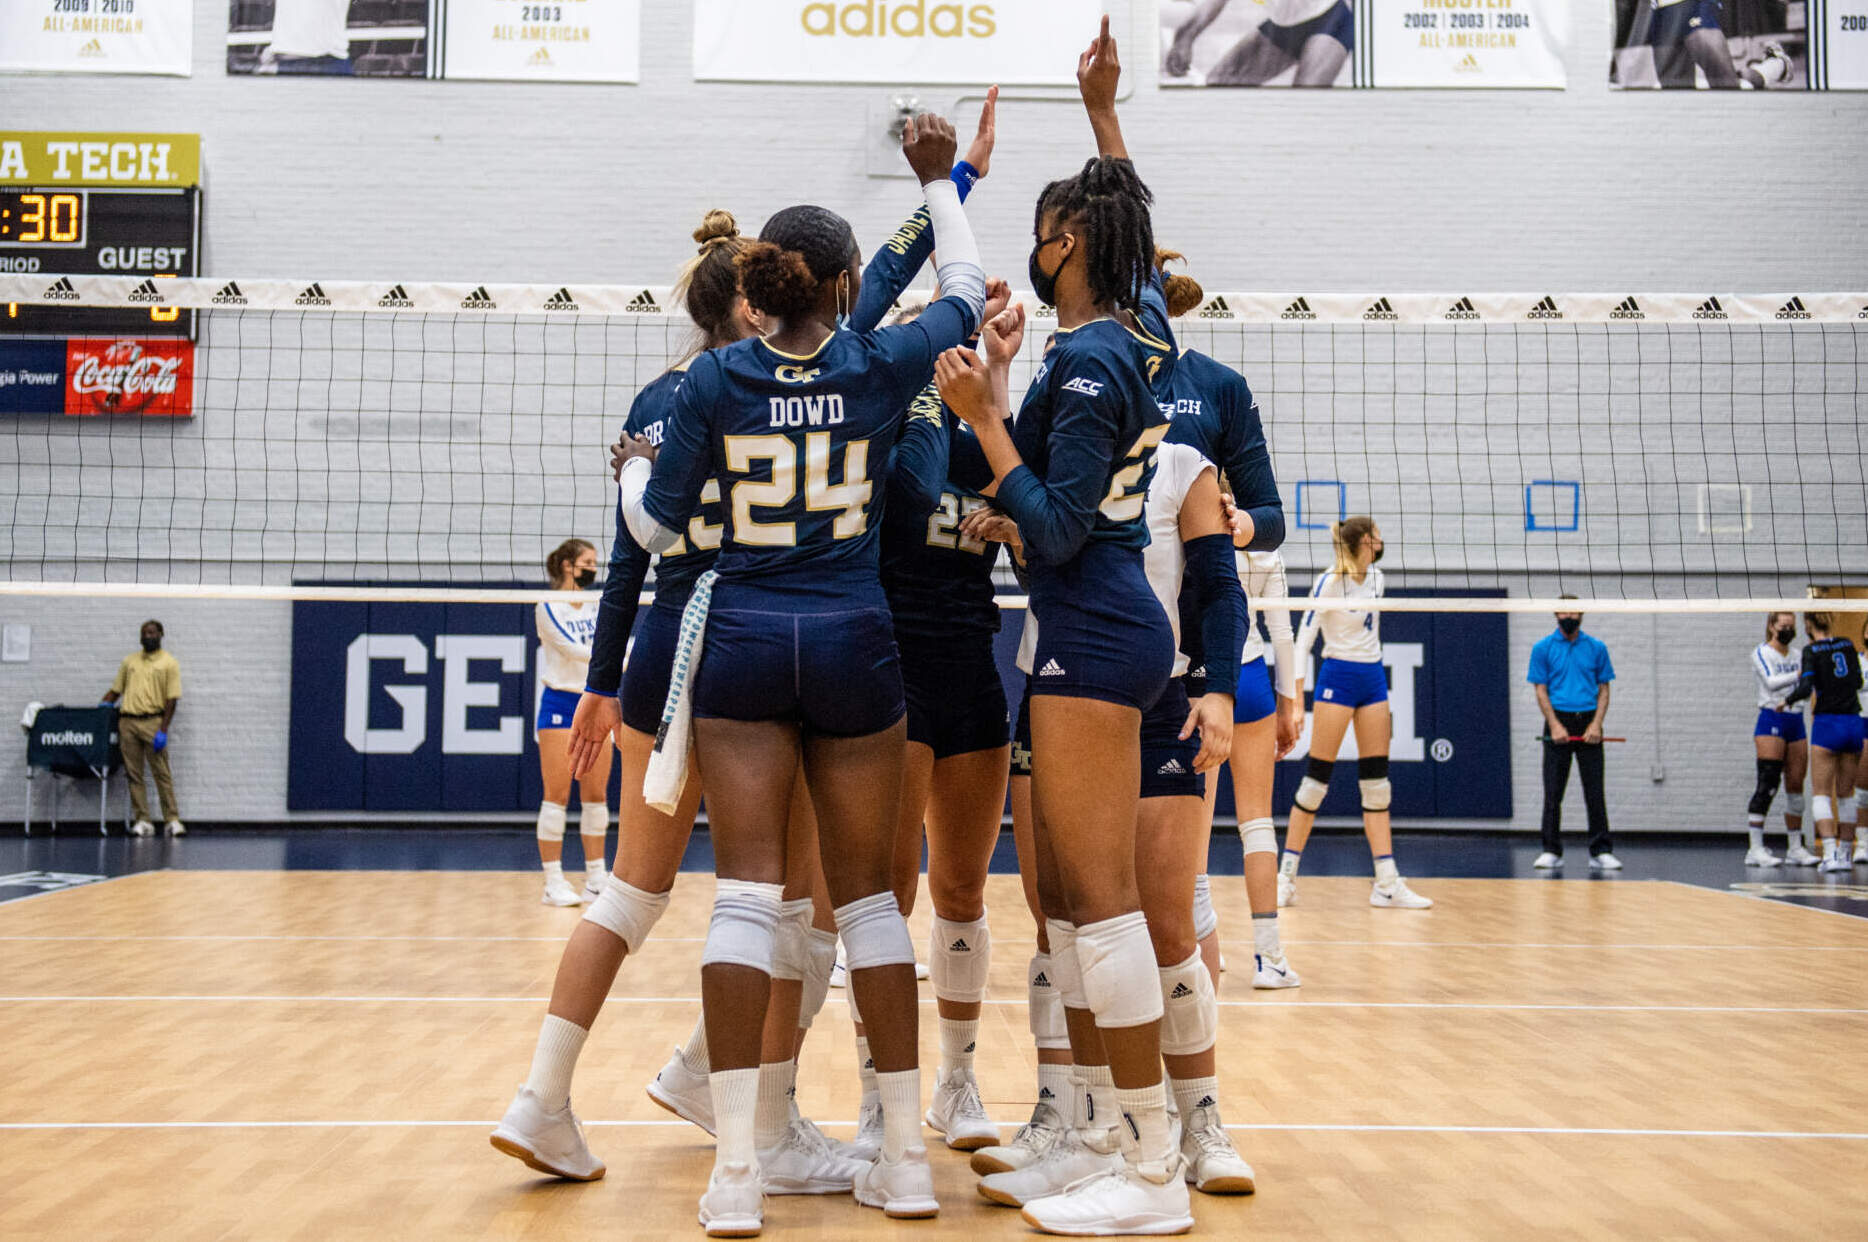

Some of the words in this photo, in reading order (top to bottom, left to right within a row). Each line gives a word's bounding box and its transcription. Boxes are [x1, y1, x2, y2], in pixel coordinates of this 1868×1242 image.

[522, 6, 562, 22] 2003
[801, 0, 997, 38] adidas
[1404, 13, 1437, 28] 2002
[1450, 13, 1484, 28] 2003
[1497, 13, 1530, 28] 2004
[98, 246, 187, 270] GUEST
[43, 292, 80, 301] adidas
[128, 294, 164, 303] adidas
[212, 296, 248, 305] adidas
[295, 297, 331, 306] adidas
[378, 298, 414, 308] adidas
[461, 300, 497, 310] adidas
[543, 301, 579, 311] adidas
[626, 303, 661, 313] adidas
[1199, 309, 1235, 319] adidas
[1281, 310, 1317, 320] adidas
[1363, 310, 1398, 320] adidas
[1445, 310, 1480, 320] adidas
[1527, 310, 1563, 319] adidas
[1609, 310, 1645, 319] adidas
[1692, 310, 1728, 320] adidas
[1775, 310, 1811, 320] adidas
[20, 370, 59, 385] Power
[1062, 377, 1104, 396] ACC
[769, 394, 844, 427] DOWD
[724, 431, 873, 547] 24
[1363, 612, 1374, 631] 4
[1832, 651, 1848, 678] 3
[41, 730, 94, 746] molten
